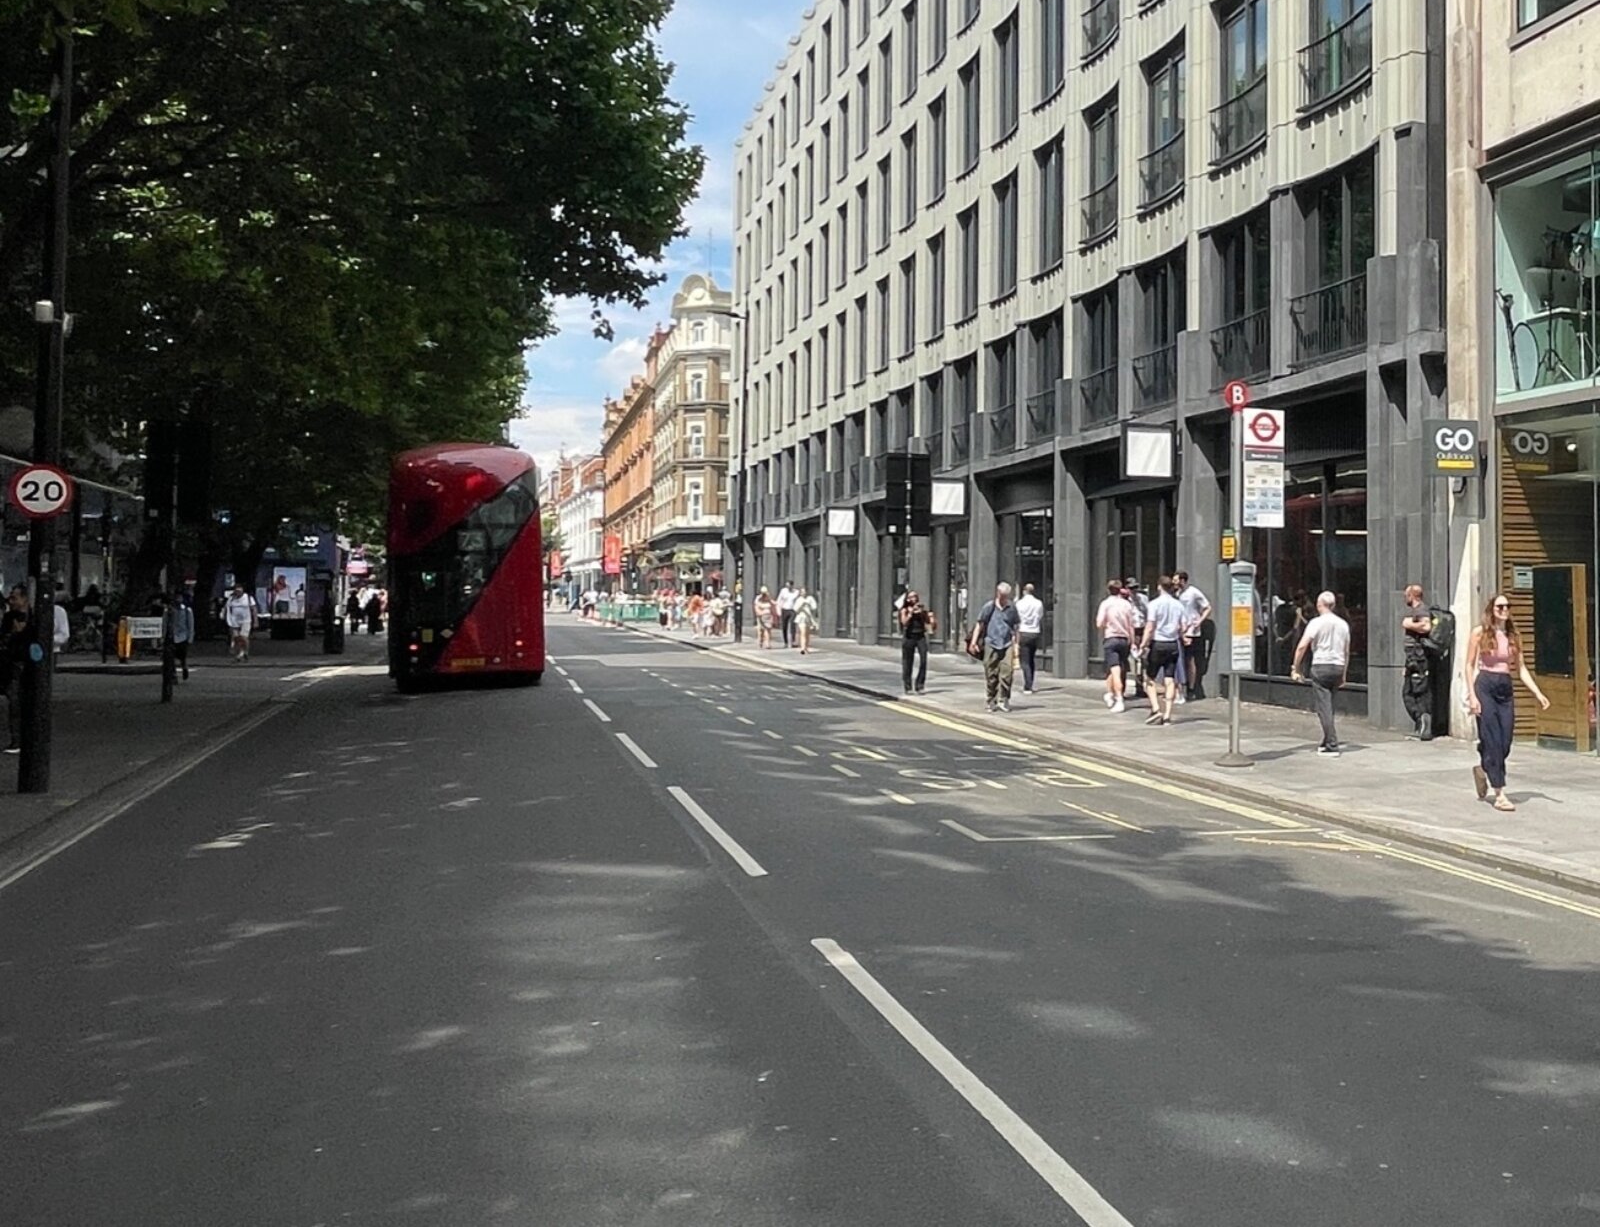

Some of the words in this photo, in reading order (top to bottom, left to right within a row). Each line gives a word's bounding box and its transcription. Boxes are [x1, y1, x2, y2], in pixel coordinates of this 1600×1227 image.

[1232, 385, 1244, 404] B
[1435, 427, 1474, 451] GO
[21, 480, 63, 501] 20
